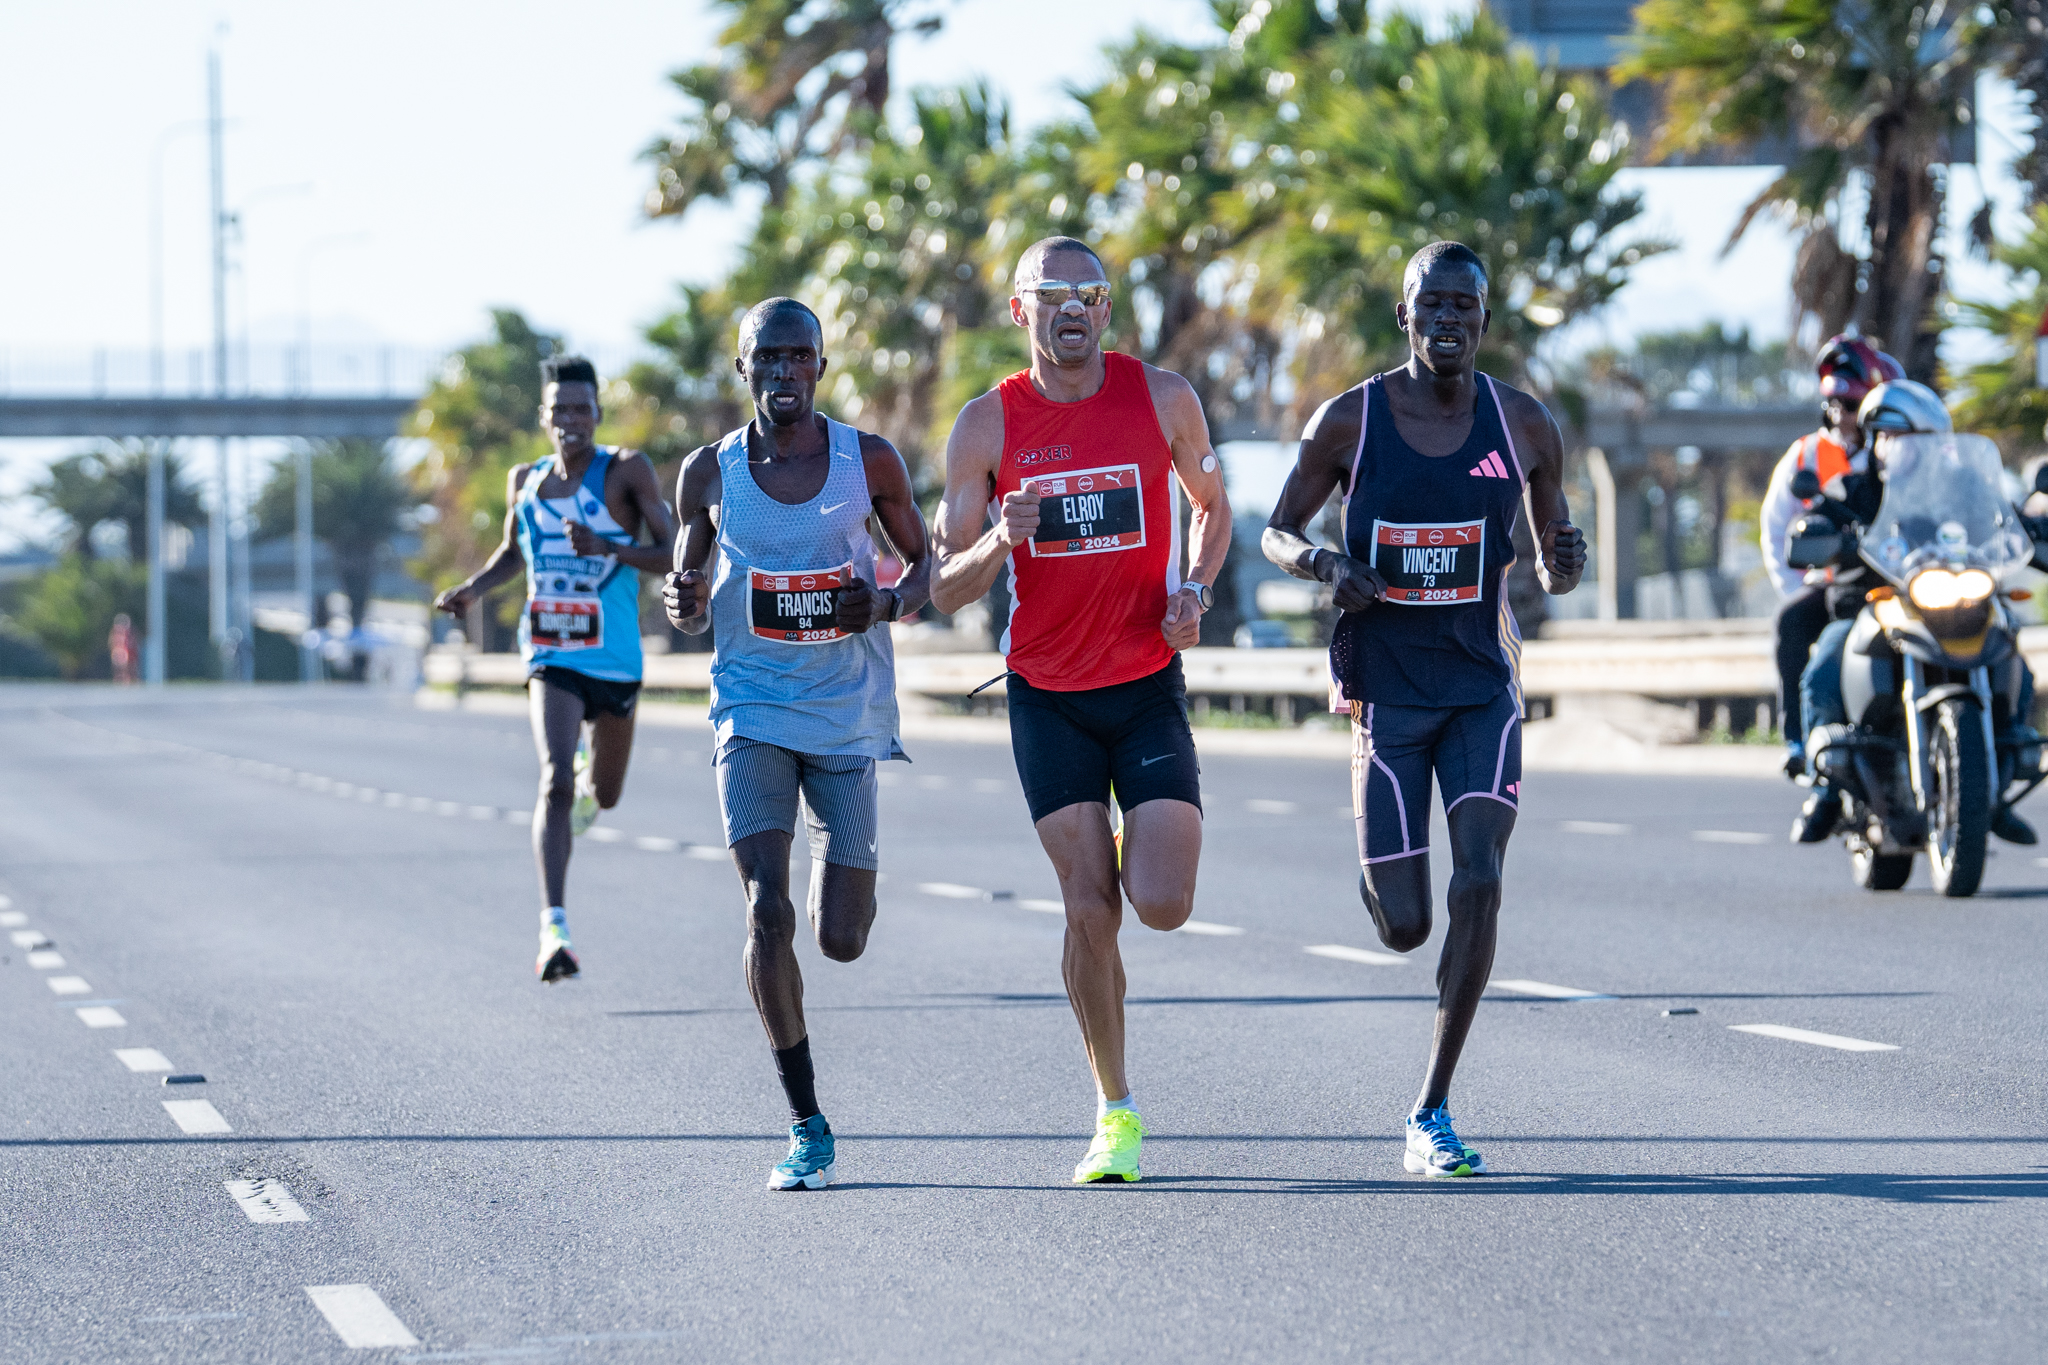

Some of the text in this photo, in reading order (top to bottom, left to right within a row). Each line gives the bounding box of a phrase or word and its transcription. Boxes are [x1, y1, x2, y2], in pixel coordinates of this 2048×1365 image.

[1015, 445, 1071, 467] BOXER
[1062, 493, 1104, 524] ELROY
[1079, 523, 1093, 536] 61
[1084, 535, 1120, 549] 2024
[1403, 548, 1458, 573] VINCENT
[1422, 575, 1436, 588] 73
[1423, 589, 1458, 601] 2024
[777, 591, 832, 616] FRANCIS
[798, 617, 812, 629] 94
[802, 628, 837, 641] 2024
